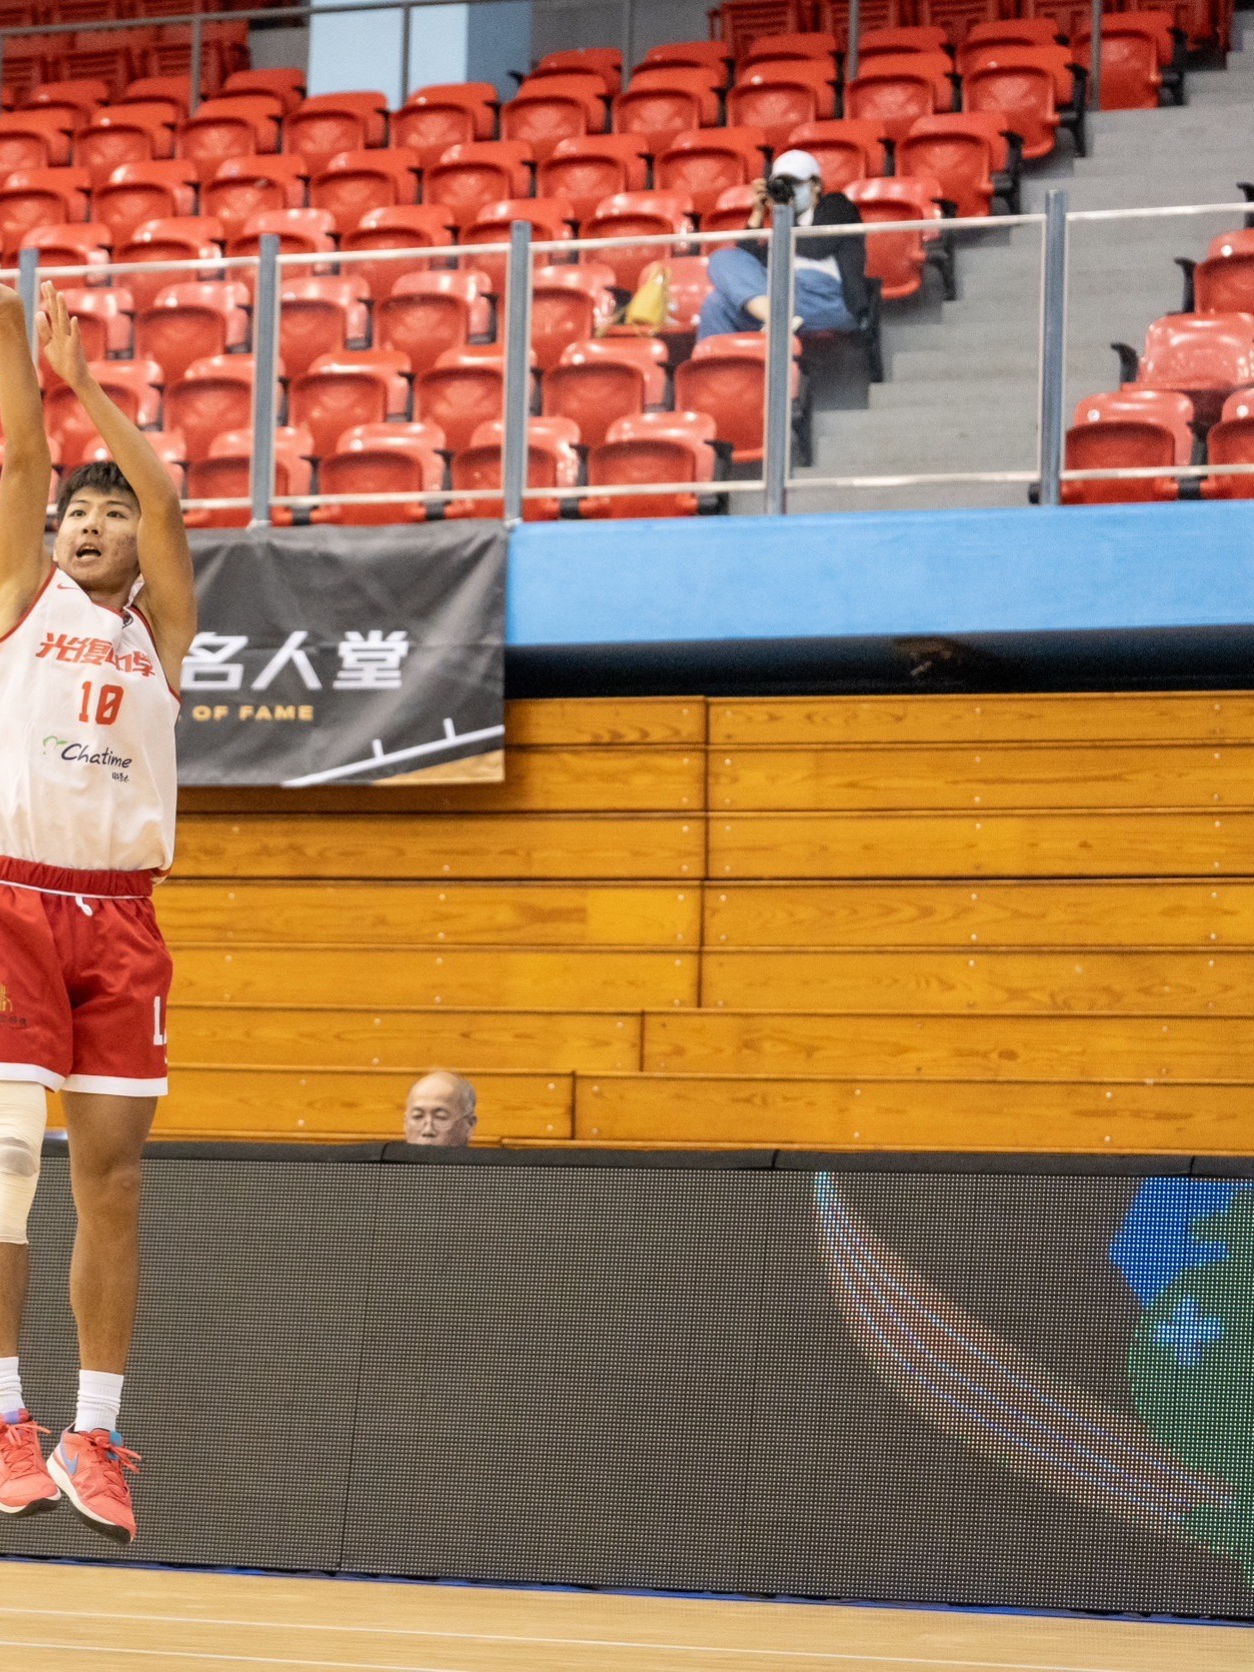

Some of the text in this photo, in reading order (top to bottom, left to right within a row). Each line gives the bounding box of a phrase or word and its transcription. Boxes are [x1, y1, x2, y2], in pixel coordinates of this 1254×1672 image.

[78, 680, 124, 725] 10
[192, 705, 314, 722] OF FAME
[61, 743, 133, 769] Chatime
